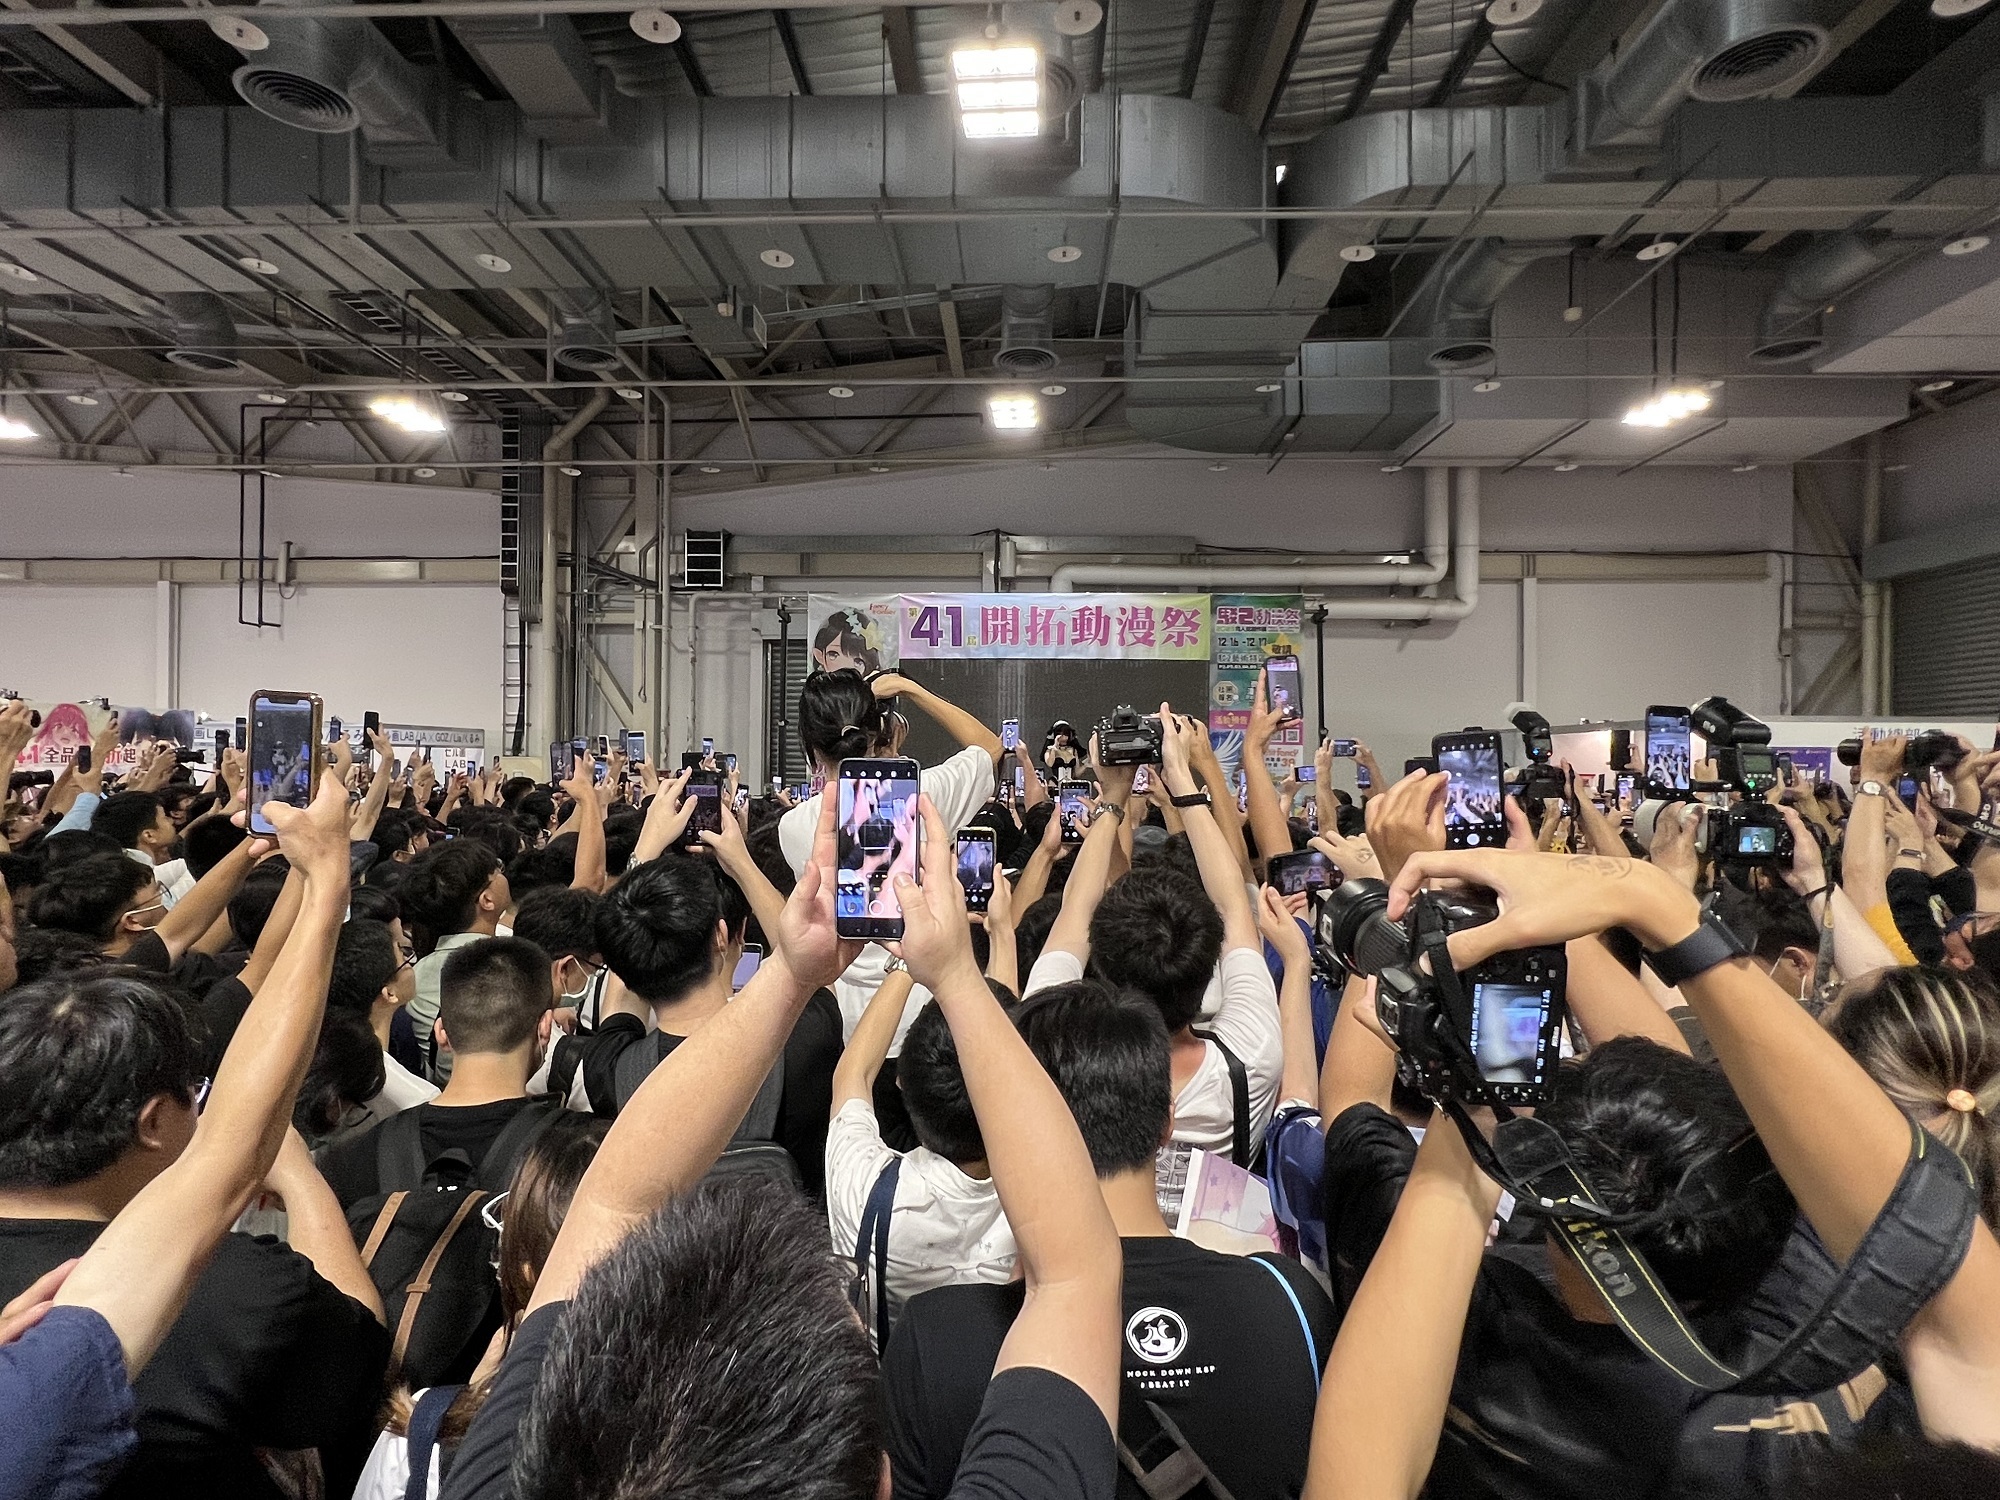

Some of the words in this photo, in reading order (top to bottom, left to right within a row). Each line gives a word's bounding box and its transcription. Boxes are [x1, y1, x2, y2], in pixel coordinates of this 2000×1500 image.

[445, 759, 466, 768] LAB
[1161, 1368, 1192, 1377] DOWN
[1180, 1379, 1190, 1388] IT
